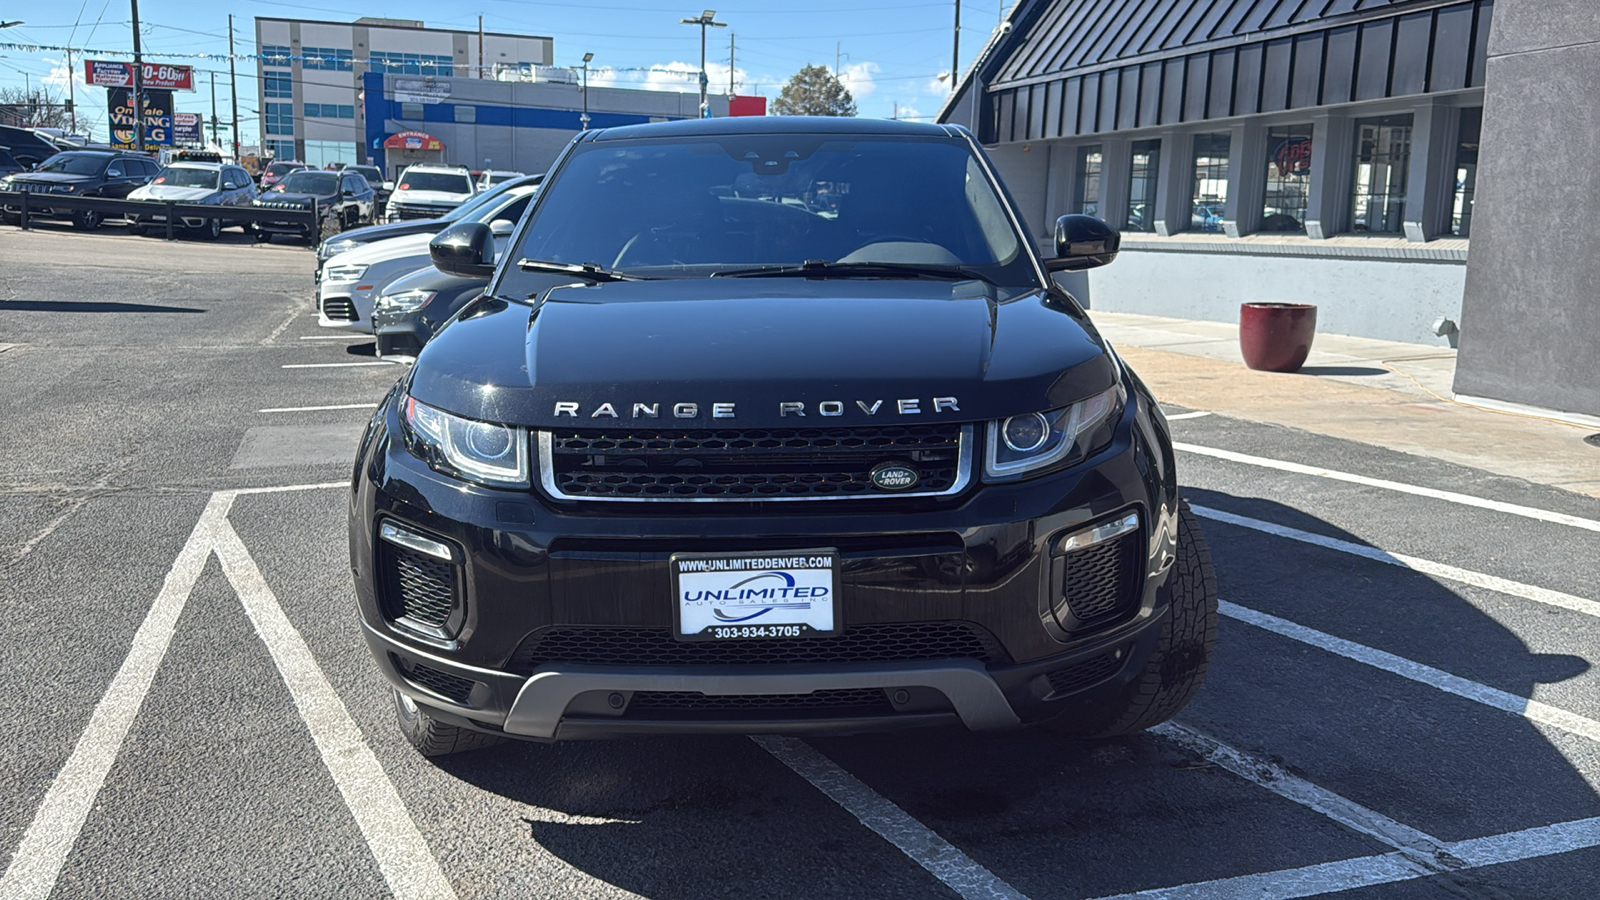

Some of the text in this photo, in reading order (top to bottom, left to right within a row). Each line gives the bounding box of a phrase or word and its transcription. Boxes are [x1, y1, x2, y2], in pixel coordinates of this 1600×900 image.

[142, 65, 175, 80] 0-60
[115, 106, 164, 116] On ale
[109, 113, 171, 128] VIING
[398, 131, 429, 139] ENTRANCE
[553, 397, 961, 419] RANGE ROVER
[678, 556, 832, 572] WWWUNLIMITEDDENVER.COM
[684, 586, 829, 601] UNLIMITED
[714, 625, 801, 639] 303-934-3705
